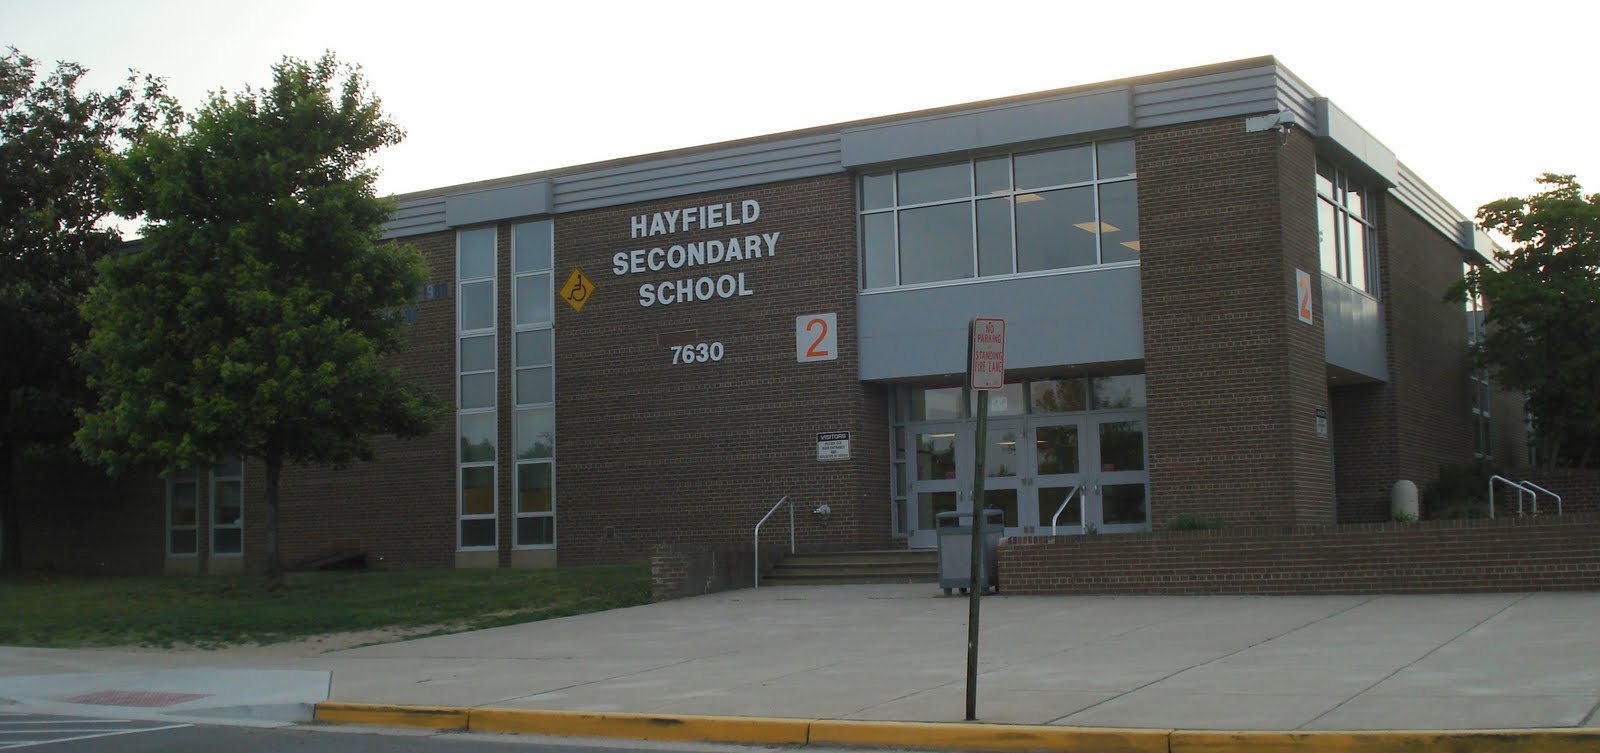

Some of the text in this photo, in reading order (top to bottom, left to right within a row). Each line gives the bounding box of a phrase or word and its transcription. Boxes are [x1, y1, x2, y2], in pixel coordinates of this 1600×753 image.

[631, 200, 760, 238] HAYFIELD
[612, 232, 780, 275] SECONDARY
[639, 272, 753, 307] SCHOOL
[1299, 276, 1310, 320] 2
[806, 318, 829, 358] 2
[977, 334, 1002, 343] PARKING
[985, 325, 994, 333] NO
[670, 341, 724, 364] 7630
[975, 351, 1003, 360] STANDING
[975, 361, 1002, 372] FIRE LANE
